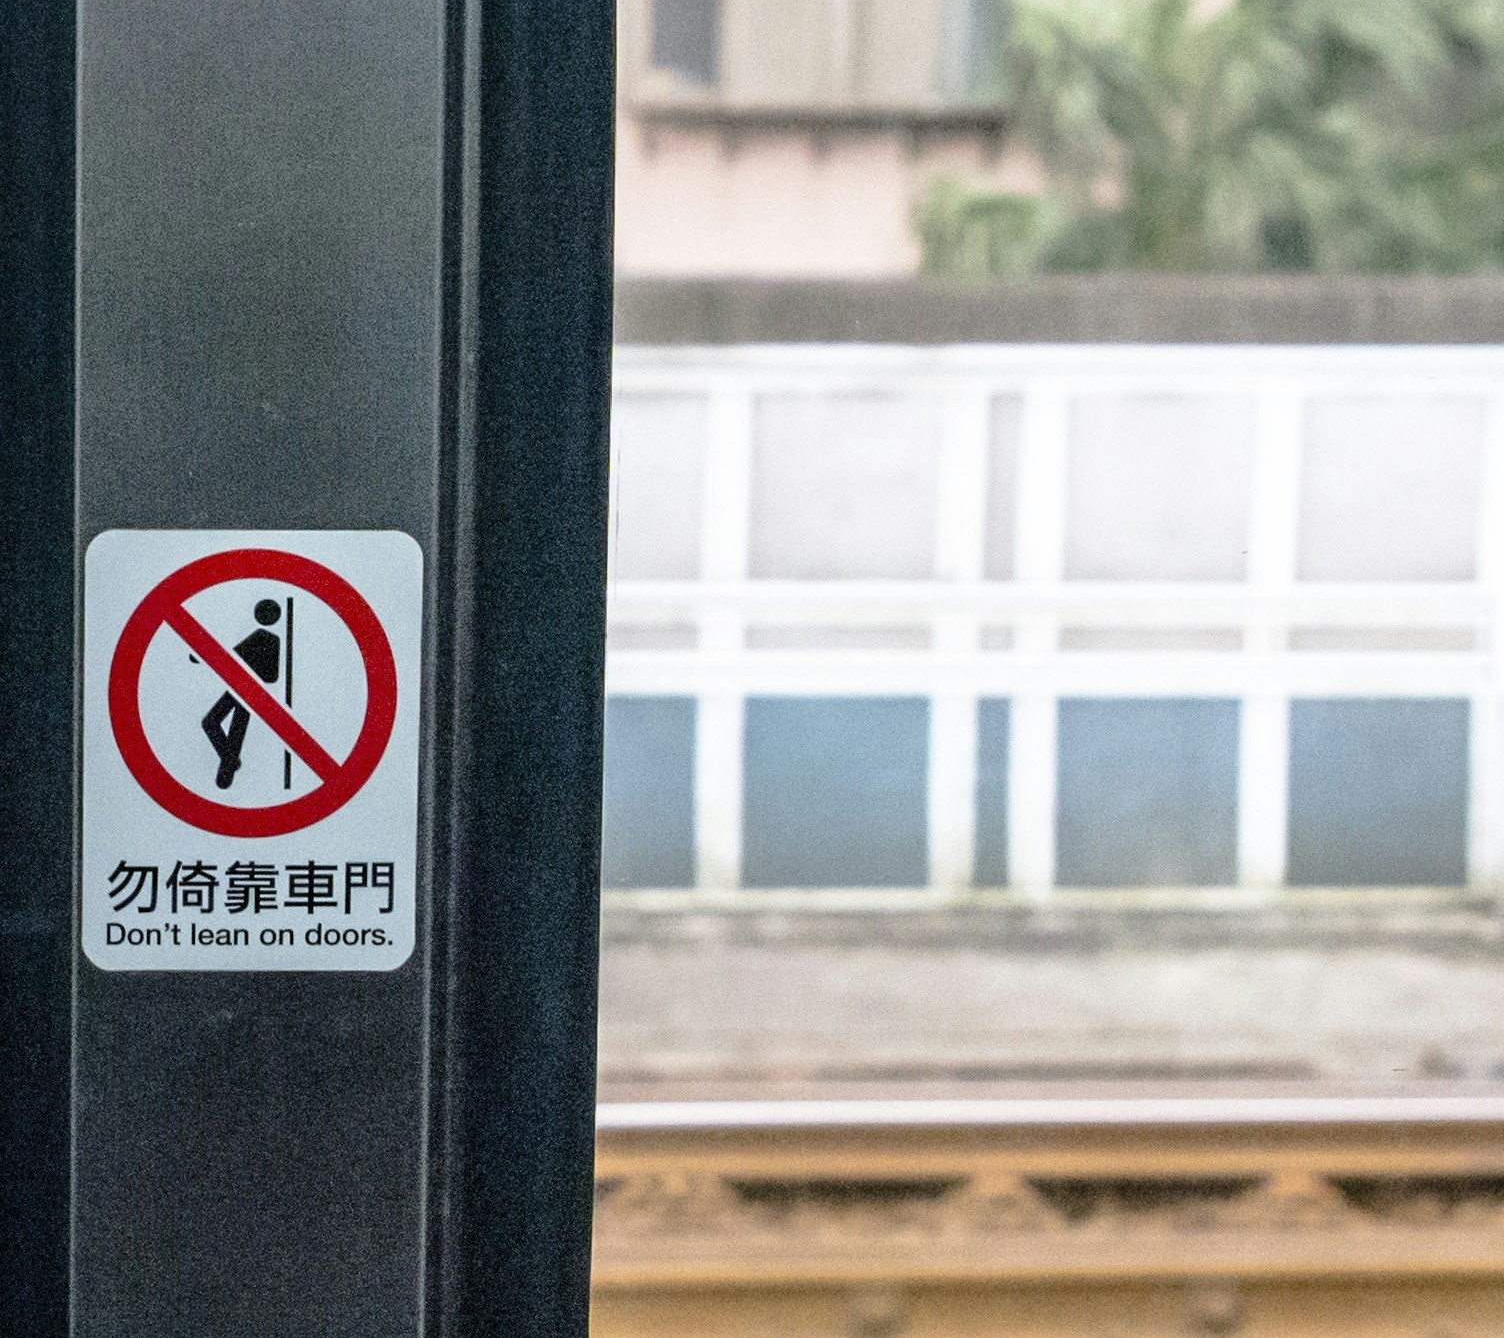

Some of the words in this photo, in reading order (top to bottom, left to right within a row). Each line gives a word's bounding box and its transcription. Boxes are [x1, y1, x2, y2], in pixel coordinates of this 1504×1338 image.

[108, 860, 395, 915] 勿倚靠車門
[105, 922, 181, 946] Don’t
[190, 922, 250, 947] lean
[259, 928, 295, 947] on
[304, 922, 394, 947] doors.
